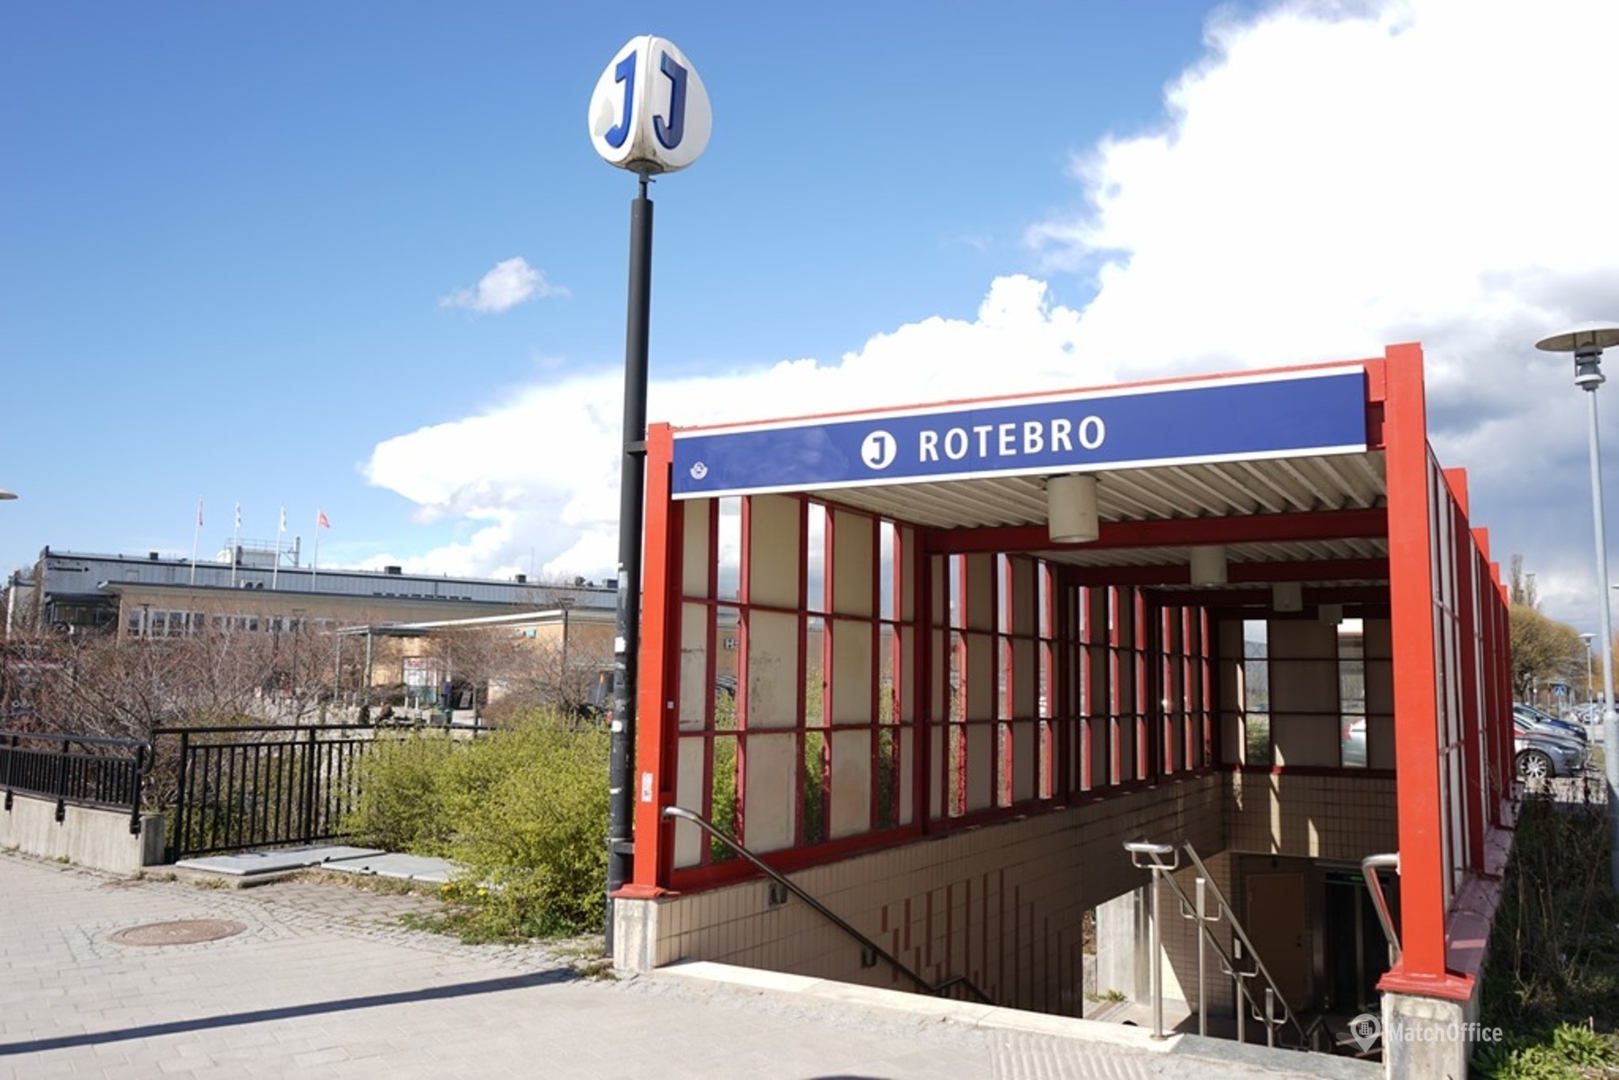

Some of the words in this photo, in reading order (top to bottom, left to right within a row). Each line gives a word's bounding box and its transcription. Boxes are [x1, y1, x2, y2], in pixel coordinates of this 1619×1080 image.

[604, 49, 637, 149] J
[653, 50, 688, 150] J
[870, 436, 886, 465] J
[920, 415, 1106, 462] ROTEBRO
